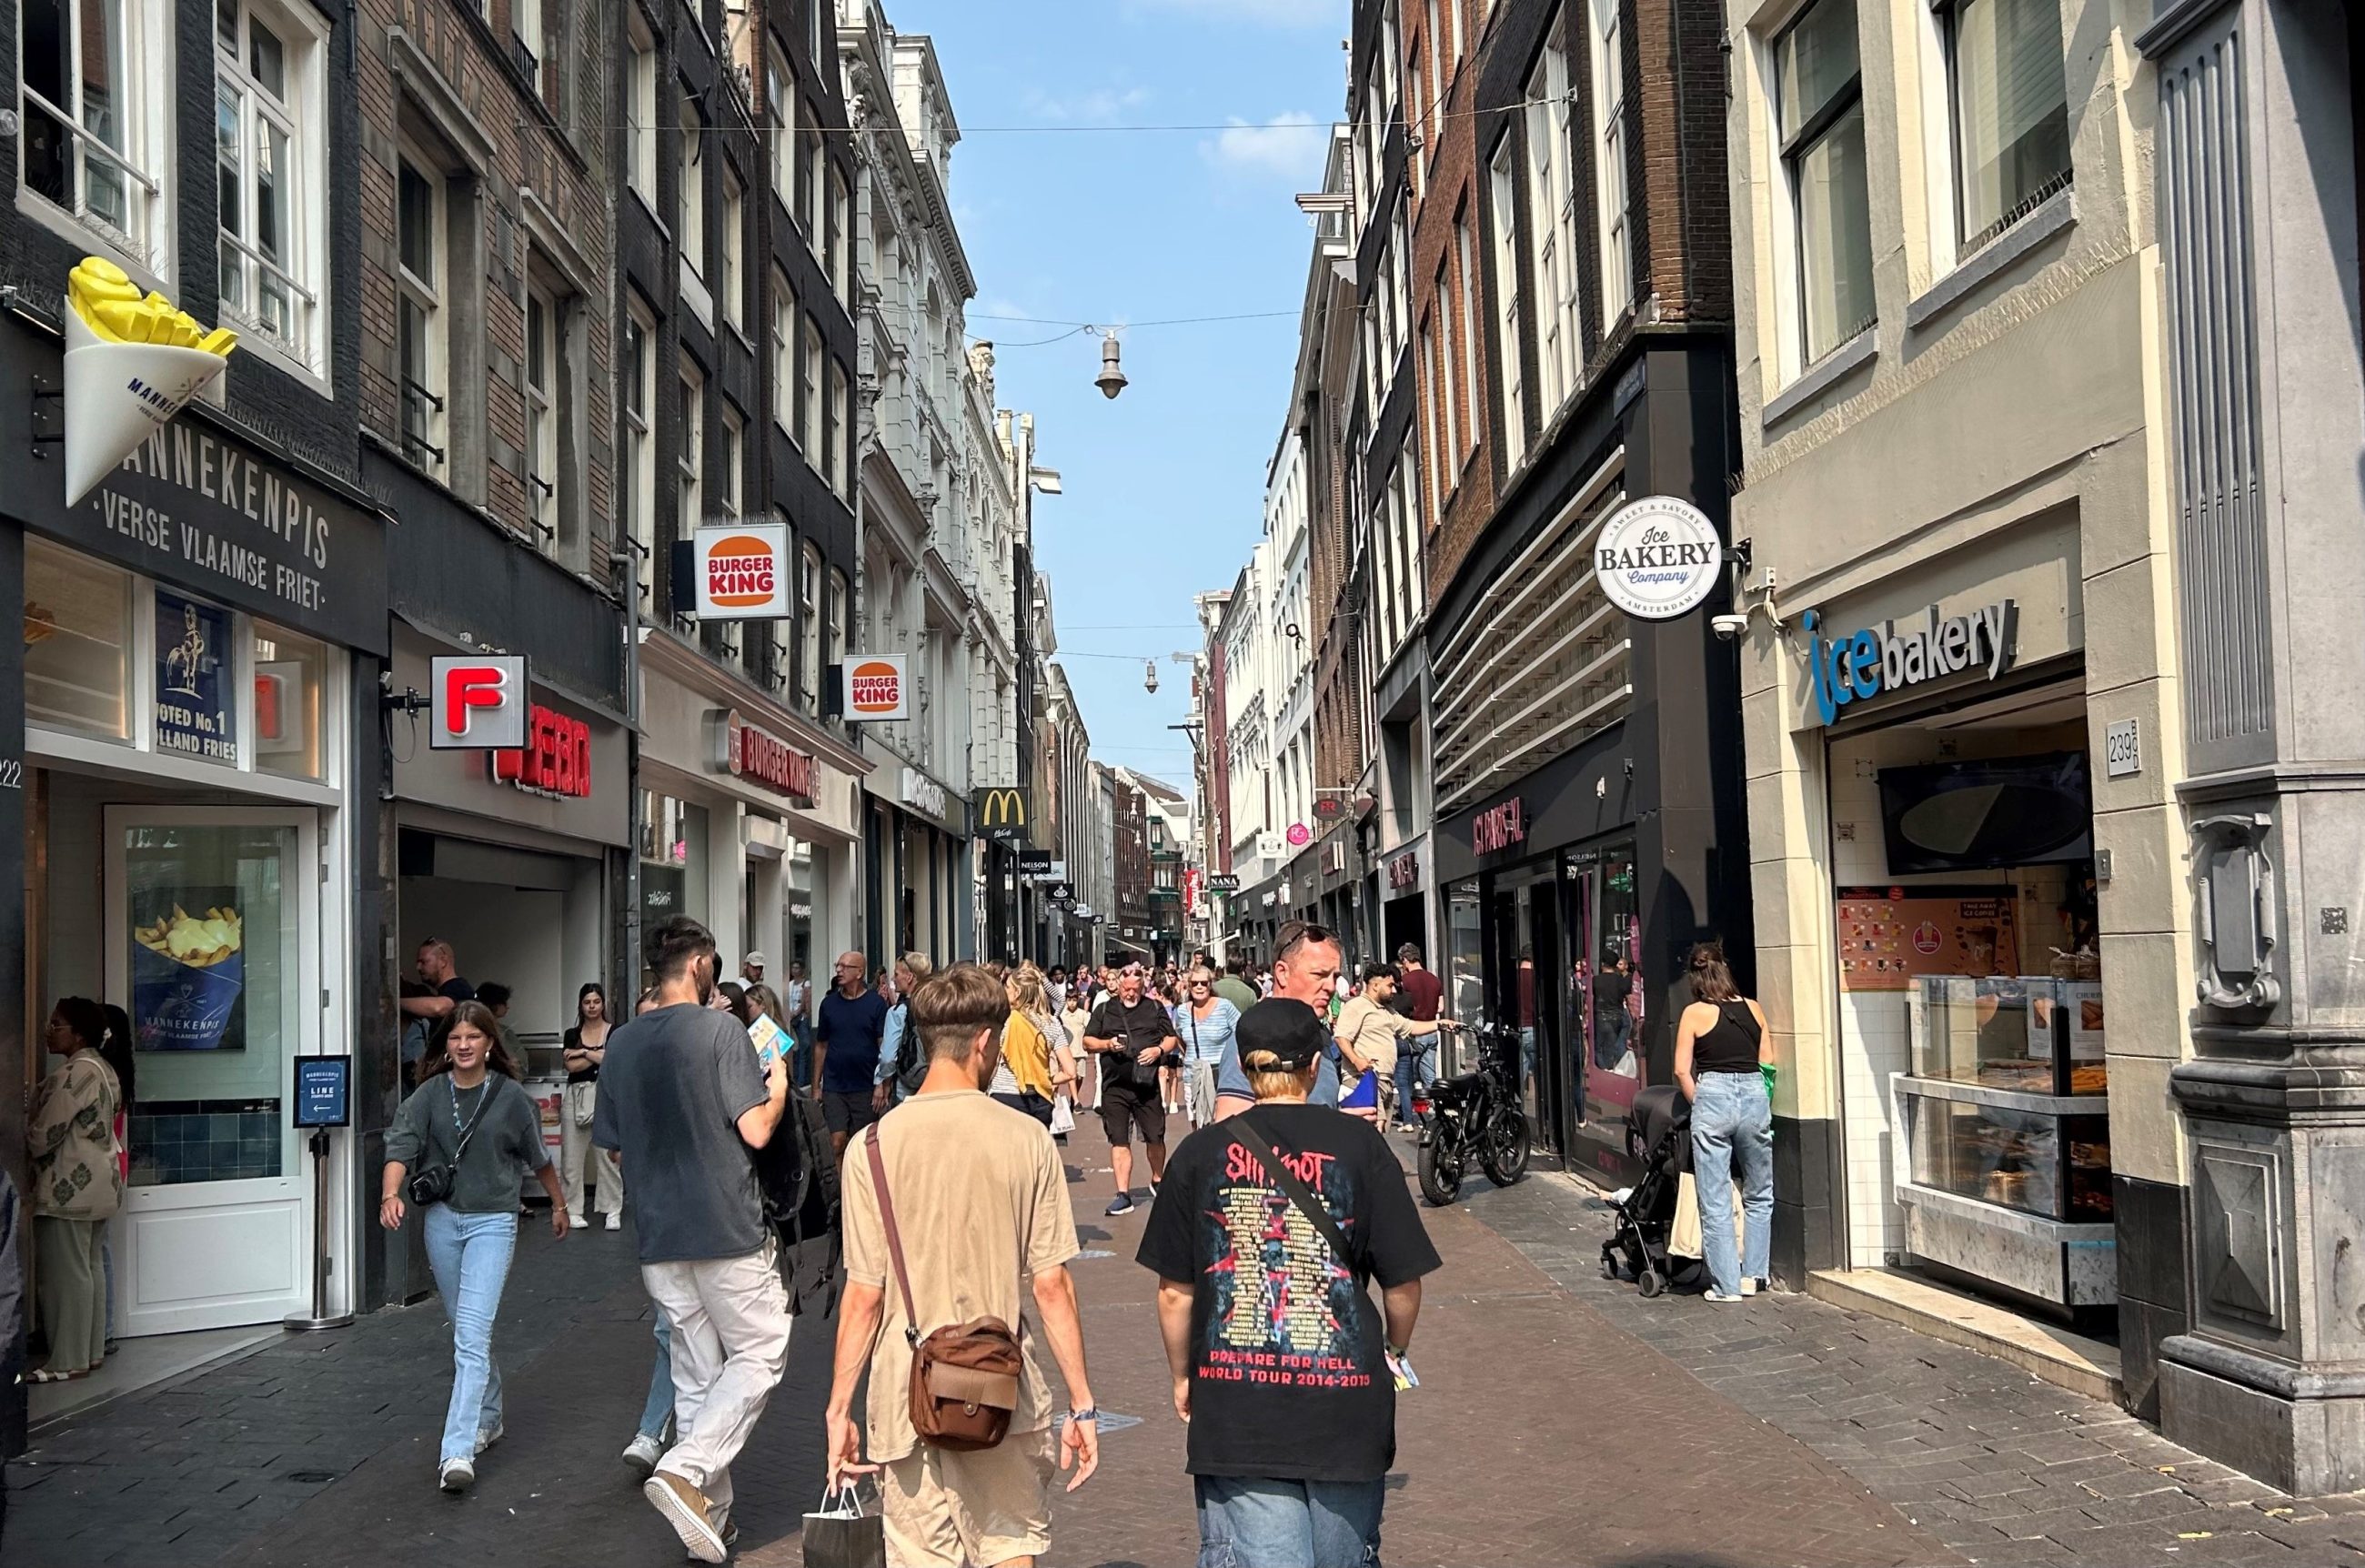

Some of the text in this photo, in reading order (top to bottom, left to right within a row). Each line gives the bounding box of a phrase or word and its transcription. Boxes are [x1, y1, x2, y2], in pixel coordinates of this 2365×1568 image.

[1613, 505, 1645, 531] SWEET
[1661, 504, 1701, 526] SAVORY
[1641, 526, 1671, 546] Ice
[102, 488, 322, 611] VERSE VLAAMSE FRIET
[1599, 541, 1716, 571] BAKERY
[709, 557, 773, 574] BURGER
[709, 572, 774, 595] KING
[1627, 570, 1690, 585] Company
[1625, 596, 1694, 613] AMSTERDAM
[852, 677, 899, 689] BURGER
[852, 688, 899, 704] KING
[156, 703, 192, 727] OTED
[203, 738, 236, 760] FRIES
[2109, 732, 2132, 763] 239
[747, 727, 789, 788] BURGER
[789, 749, 811, 798] KING
[0, 759, 21, 789] 22
[1211, 877, 1237, 886] NANA
[310, 1086, 334, 1094] LINE
[1210, 1351, 1355, 1371] PREPARE FOR HELL
[1199, 1366, 1243, 1380] WORLD
[1249, 1369, 1292, 1384] TOUR
